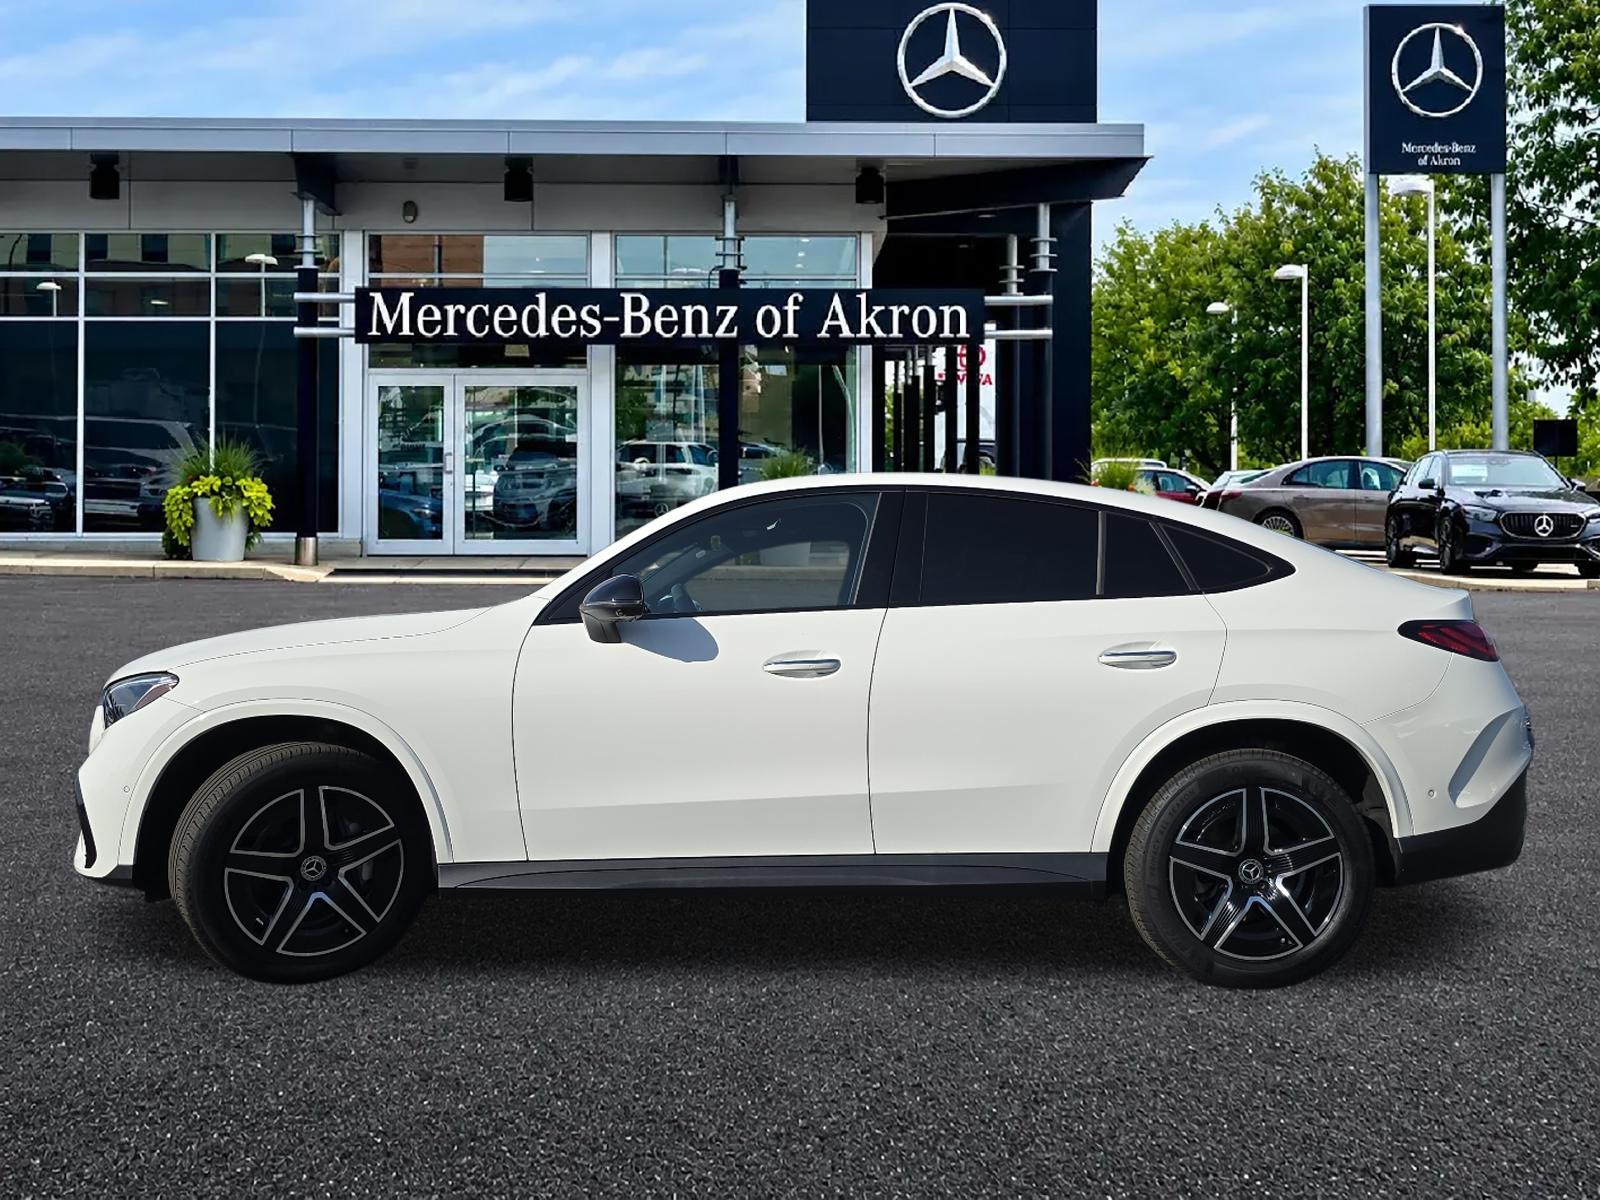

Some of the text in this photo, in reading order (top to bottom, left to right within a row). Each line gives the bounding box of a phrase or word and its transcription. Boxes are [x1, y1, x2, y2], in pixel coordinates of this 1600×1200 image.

[1401, 142, 1477, 154] Mercedes-Benz
[1417, 154, 1461, 166] of Akron
[368, 290, 971, 340] Mercedes-Benz of Akron
